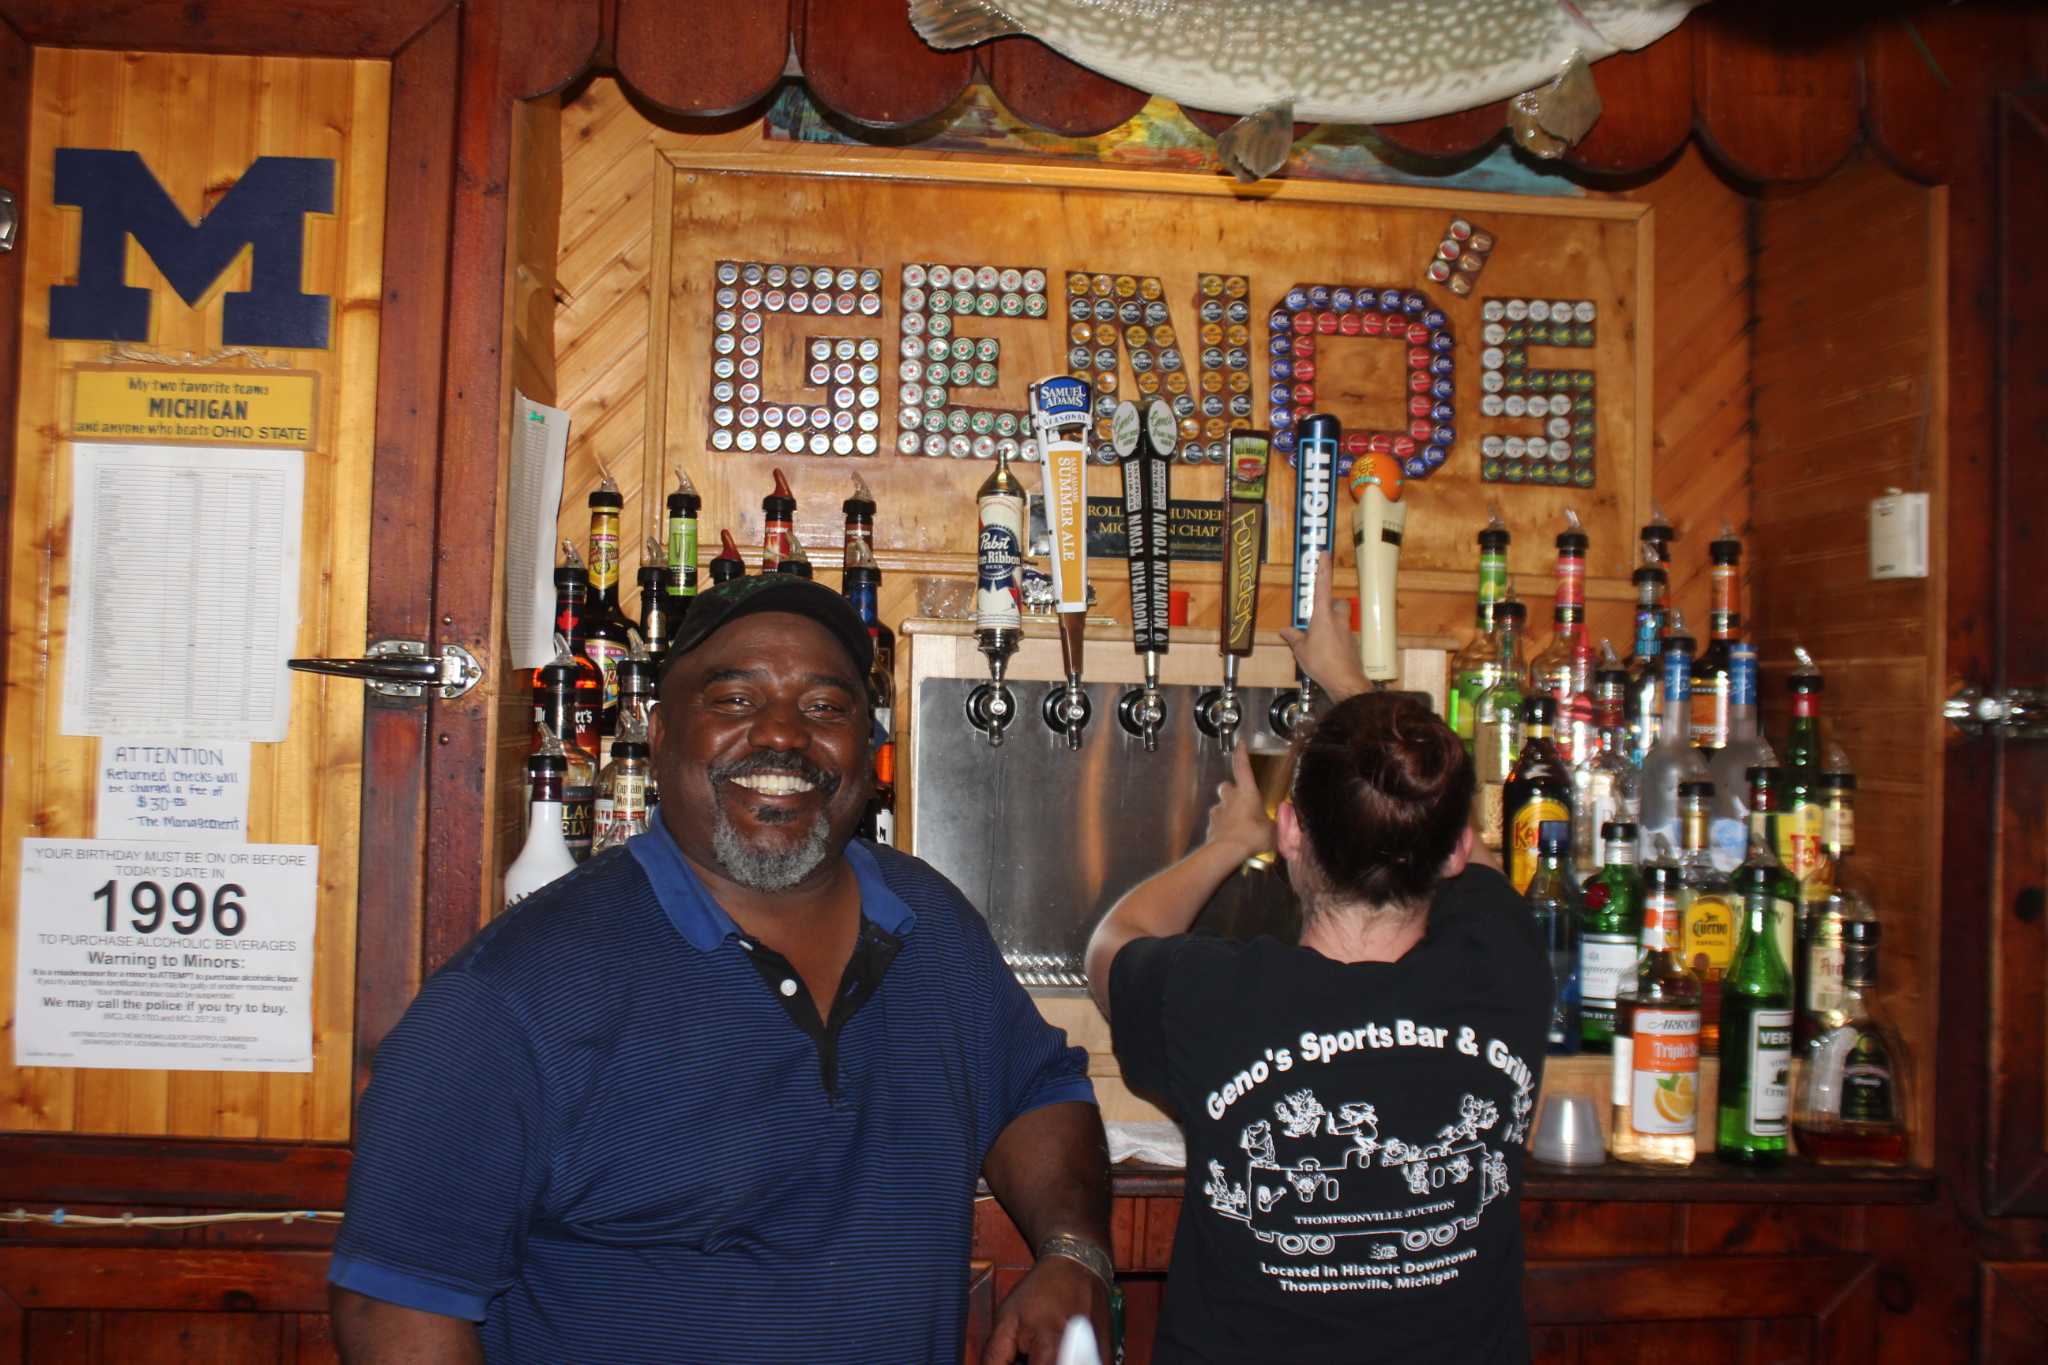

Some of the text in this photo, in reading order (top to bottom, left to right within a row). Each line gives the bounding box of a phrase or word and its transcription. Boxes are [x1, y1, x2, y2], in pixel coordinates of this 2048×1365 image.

[48, 147, 336, 350] M
[151, 379, 177, 392] two
[180, 380, 230, 394] favorite
[235, 382, 269, 396] teams
[1041, 384, 1087, 400] SAMUEL
[148, 397, 249, 421] MICHIGAN
[1046, 394, 1085, 410] ADAMS
[101, 423, 145, 435] anyone
[148, 422, 173, 435] who
[176, 423, 210, 436] beats
[212, 425, 254, 439] OHIO
[259, 426, 308, 441] STATE
[1302, 447, 1331, 546] LIGHT
[1058, 456, 1075, 561] SUMMER ALE
[981, 532, 1011, 550] Pabst
[1128, 513, 1149, 630] MOUNTAIN TOWN
[1153, 512, 1169, 630] MOUNTAIN TOWN
[115, 746, 225, 766] ATTENTION
[106, 768, 166, 782] Returned
[216, 772, 239, 784] will
[108, 784, 124, 793] be
[129, 783, 171, 794] charged
[188, 783, 208, 795] fee
[164, 815, 240, 830] Management
[35, 847, 307, 866] YOUR BIRTHDAY MUST BE ON OR BEFORE
[115, 865, 225, 879] TODAY'S DATE IN
[94, 879, 247, 937] 1996
[1692, 919, 1729, 938] Cuervo
[38, 933, 297, 952] TO PURCHASE ALCOHOLIC BEVERAGES
[88, 951, 246, 970] Warning to Minors:
[43, 997, 289, 1016] We may call the police if you try to buy.
[1206, 1049, 1293, 1121] Geno's
[1300, 1022, 1395, 1064] Sports
[1395, 1018, 1449, 1049] Bar
[1456, 1026, 1479, 1057] &
[1294, 1210, 1404, 1225] THOMPSONVILLE
[1260, 1261, 1320, 1278] Located
[1343, 1262, 1401, 1277] Historic
[1405, 1248, 1478, 1274] Downtown
[1280, 1268, 1460, 1295] Thompsonville, Michigan
